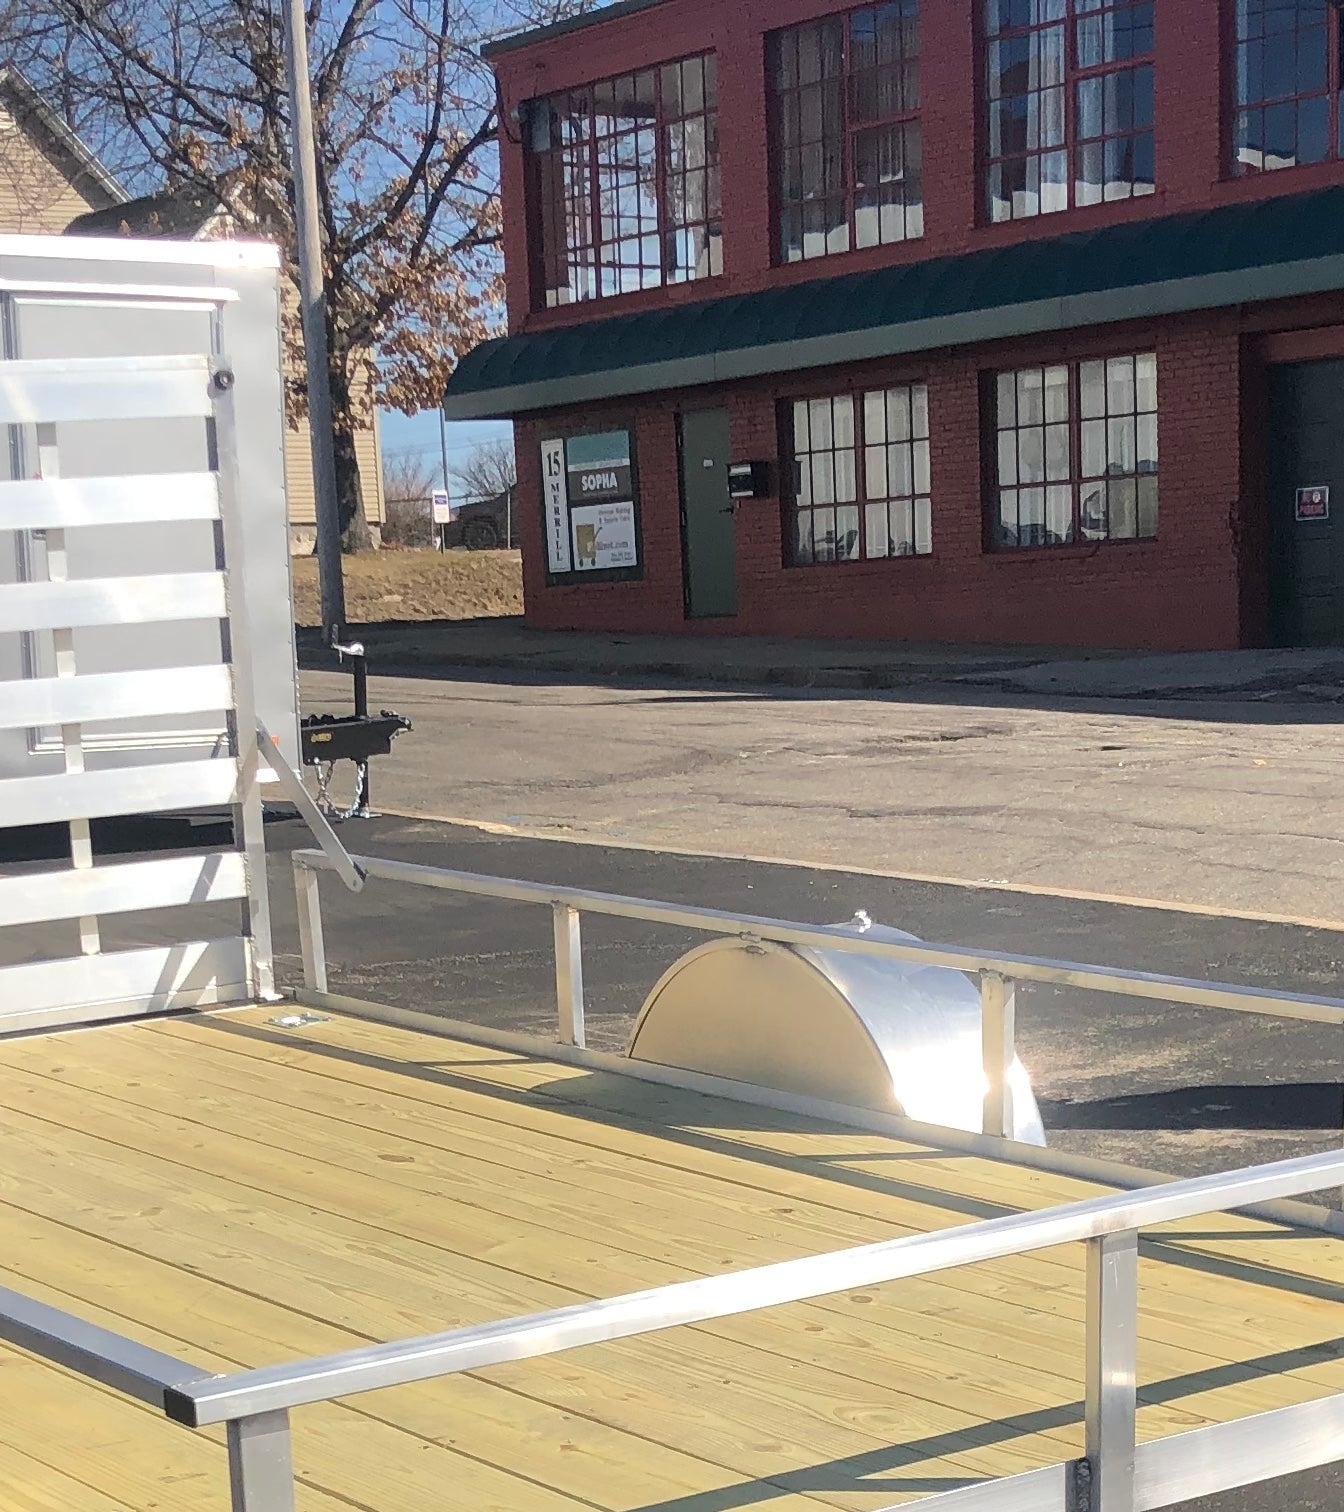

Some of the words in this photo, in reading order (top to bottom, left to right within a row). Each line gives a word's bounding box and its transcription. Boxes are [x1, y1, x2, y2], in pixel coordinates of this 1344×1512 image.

[546, 450, 561, 477] 15
[581, 472, 618, 491] SOPHA
[550, 483, 563, 562] MERRILL
